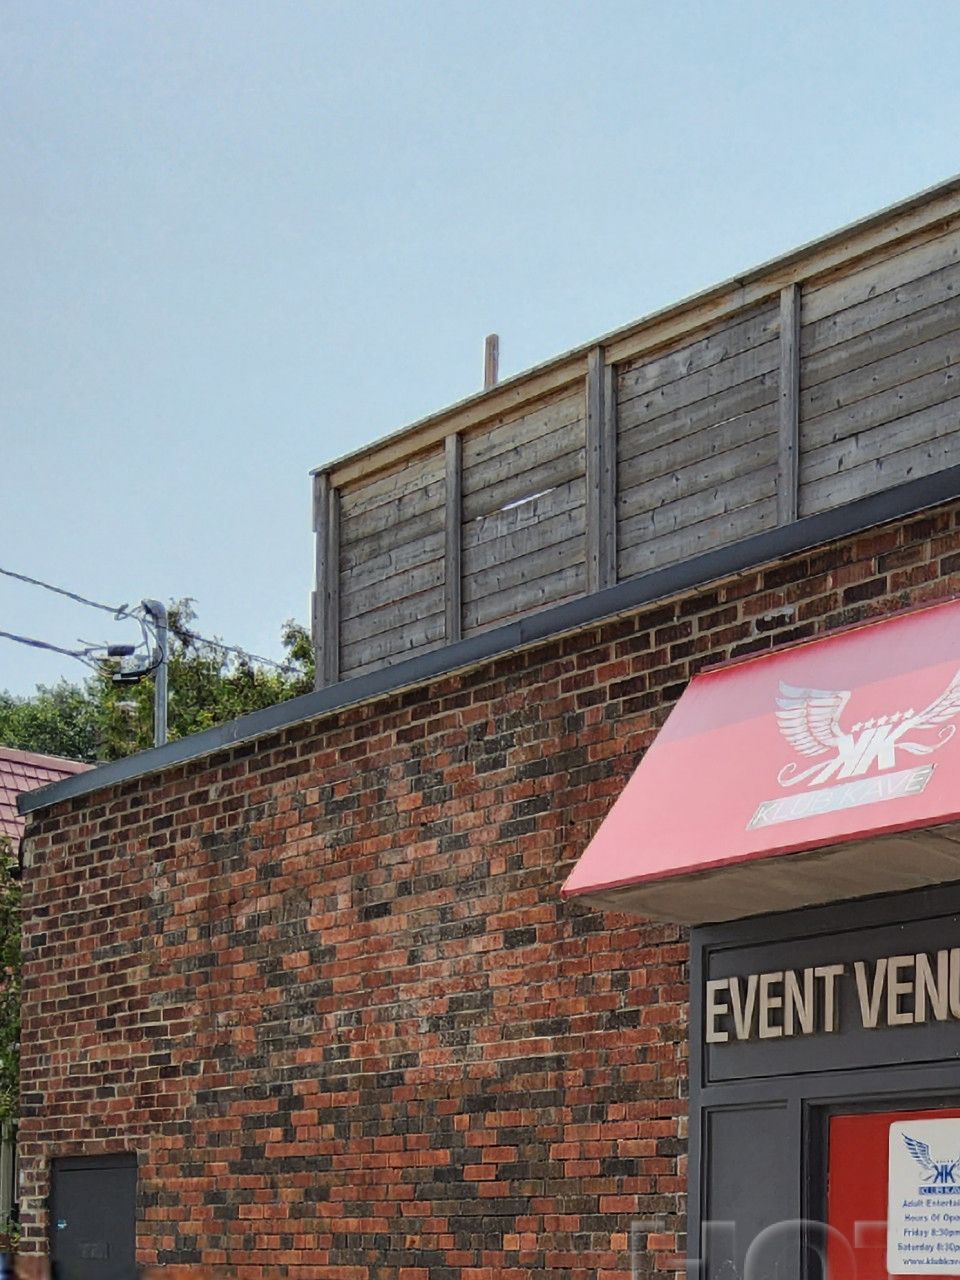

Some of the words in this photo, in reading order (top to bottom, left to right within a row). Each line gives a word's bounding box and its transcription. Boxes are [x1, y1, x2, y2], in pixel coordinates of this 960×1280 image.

[839, 769, 931, 802] KAVE
[706, 964, 845, 1043] EVENT
[903, 1200, 923, 1208] Adult
[905, 1213, 928, 1222] Hours
[931, 1213, 940, 1221] Of
[904, 1228, 928, 1237] Friday
[897, 1243, 934, 1253] Saturday
